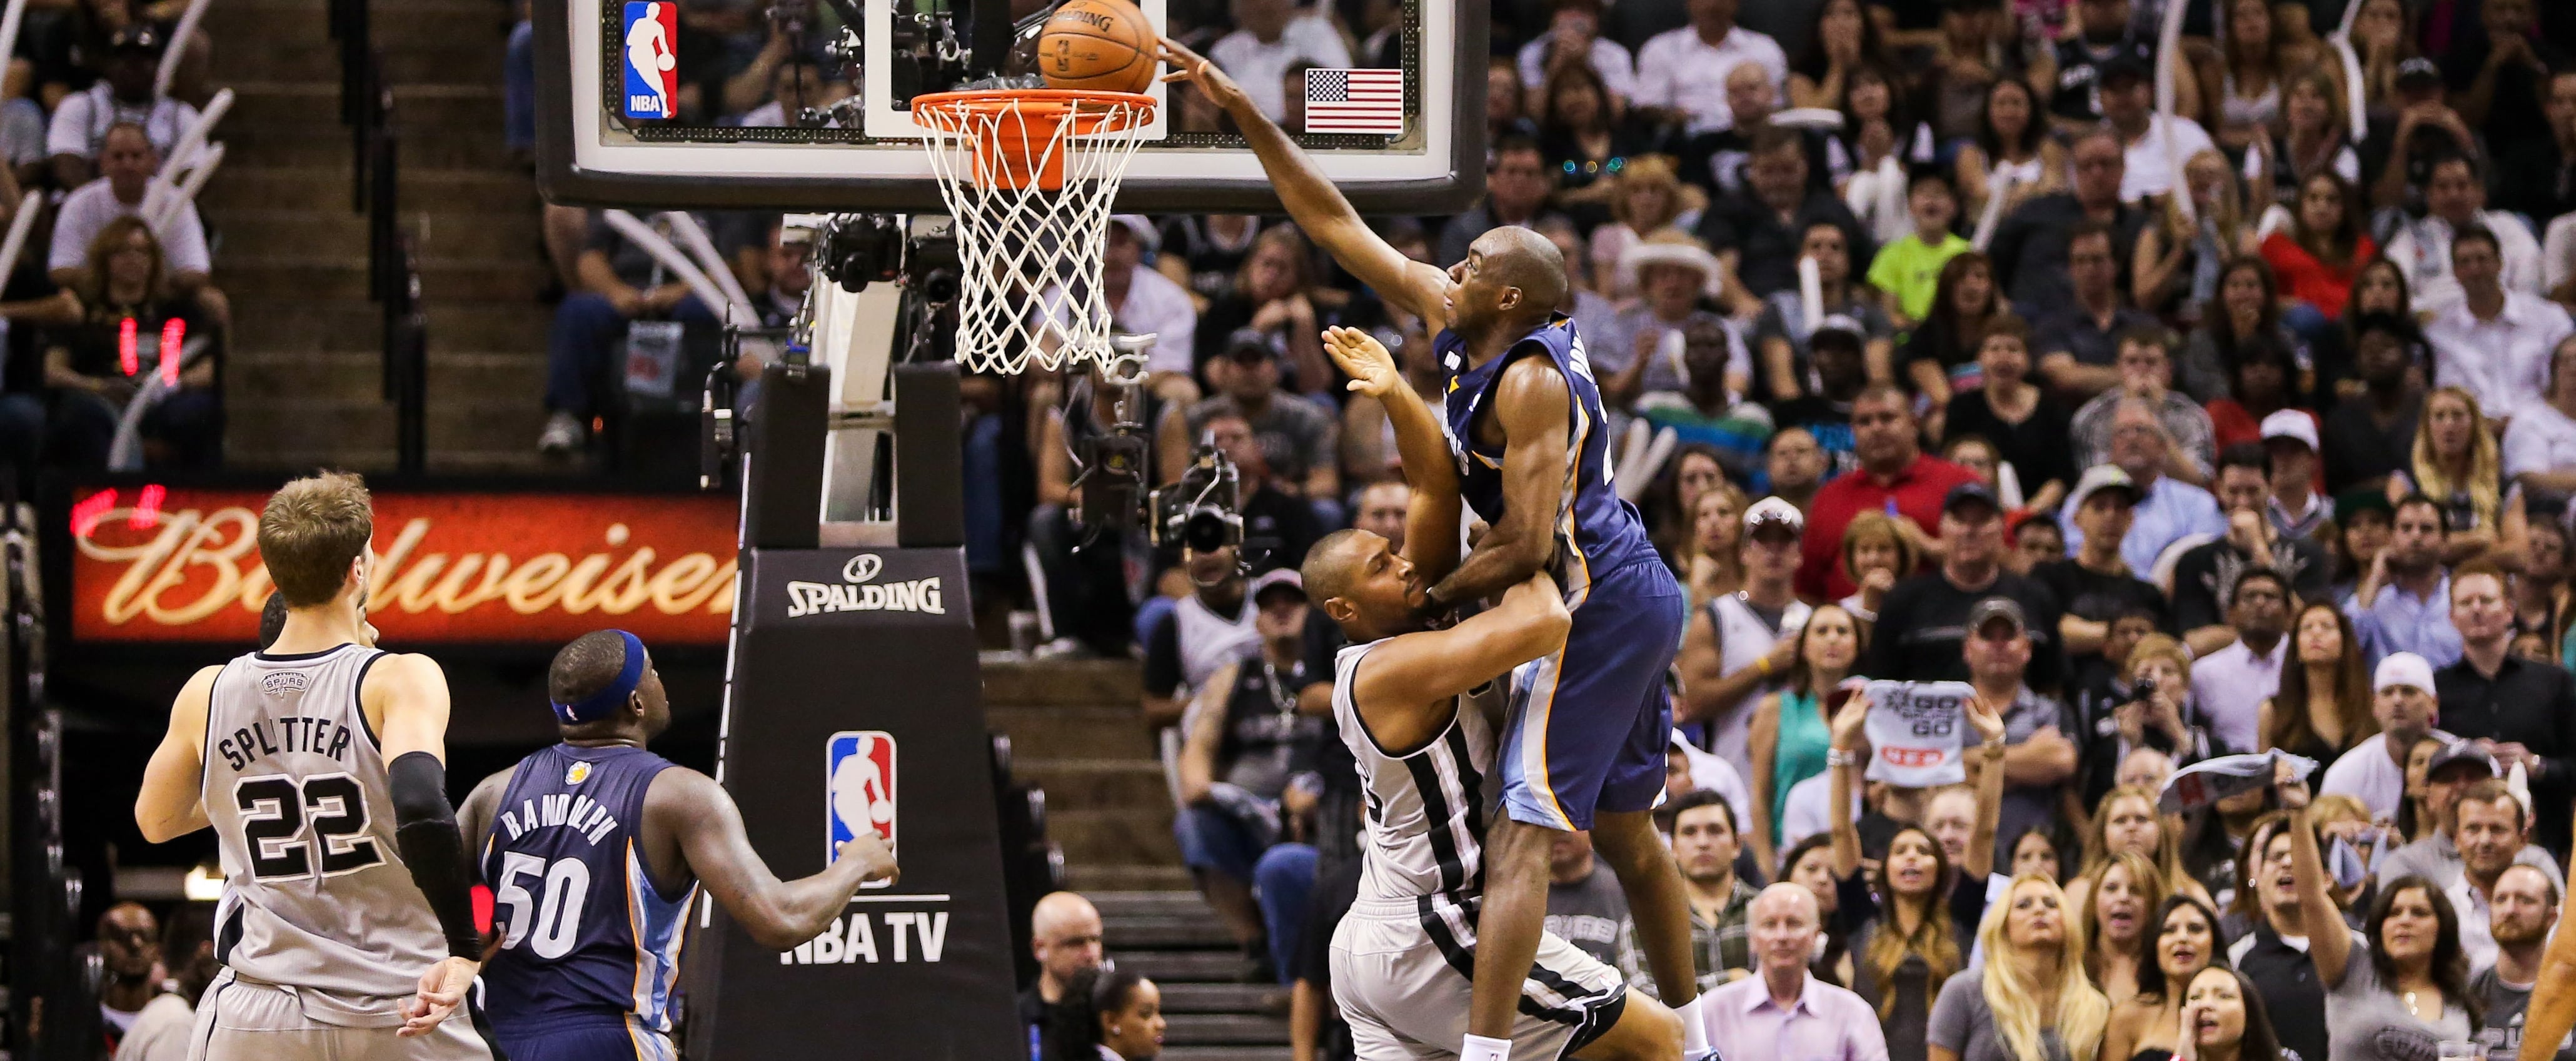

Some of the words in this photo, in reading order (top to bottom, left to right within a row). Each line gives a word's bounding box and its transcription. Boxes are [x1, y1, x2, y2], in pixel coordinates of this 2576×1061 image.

[630, 94, 661, 112] NBA
[787, 576, 946, 618] SPALDING
[266, 677, 304, 688] SPURS
[219, 717, 351, 772] SPLTTER
[233, 772, 387, 883] 22
[500, 793, 618, 847] RANDOLPH
[496, 851, 591, 960] 50
[884, 912, 949, 963] TV
